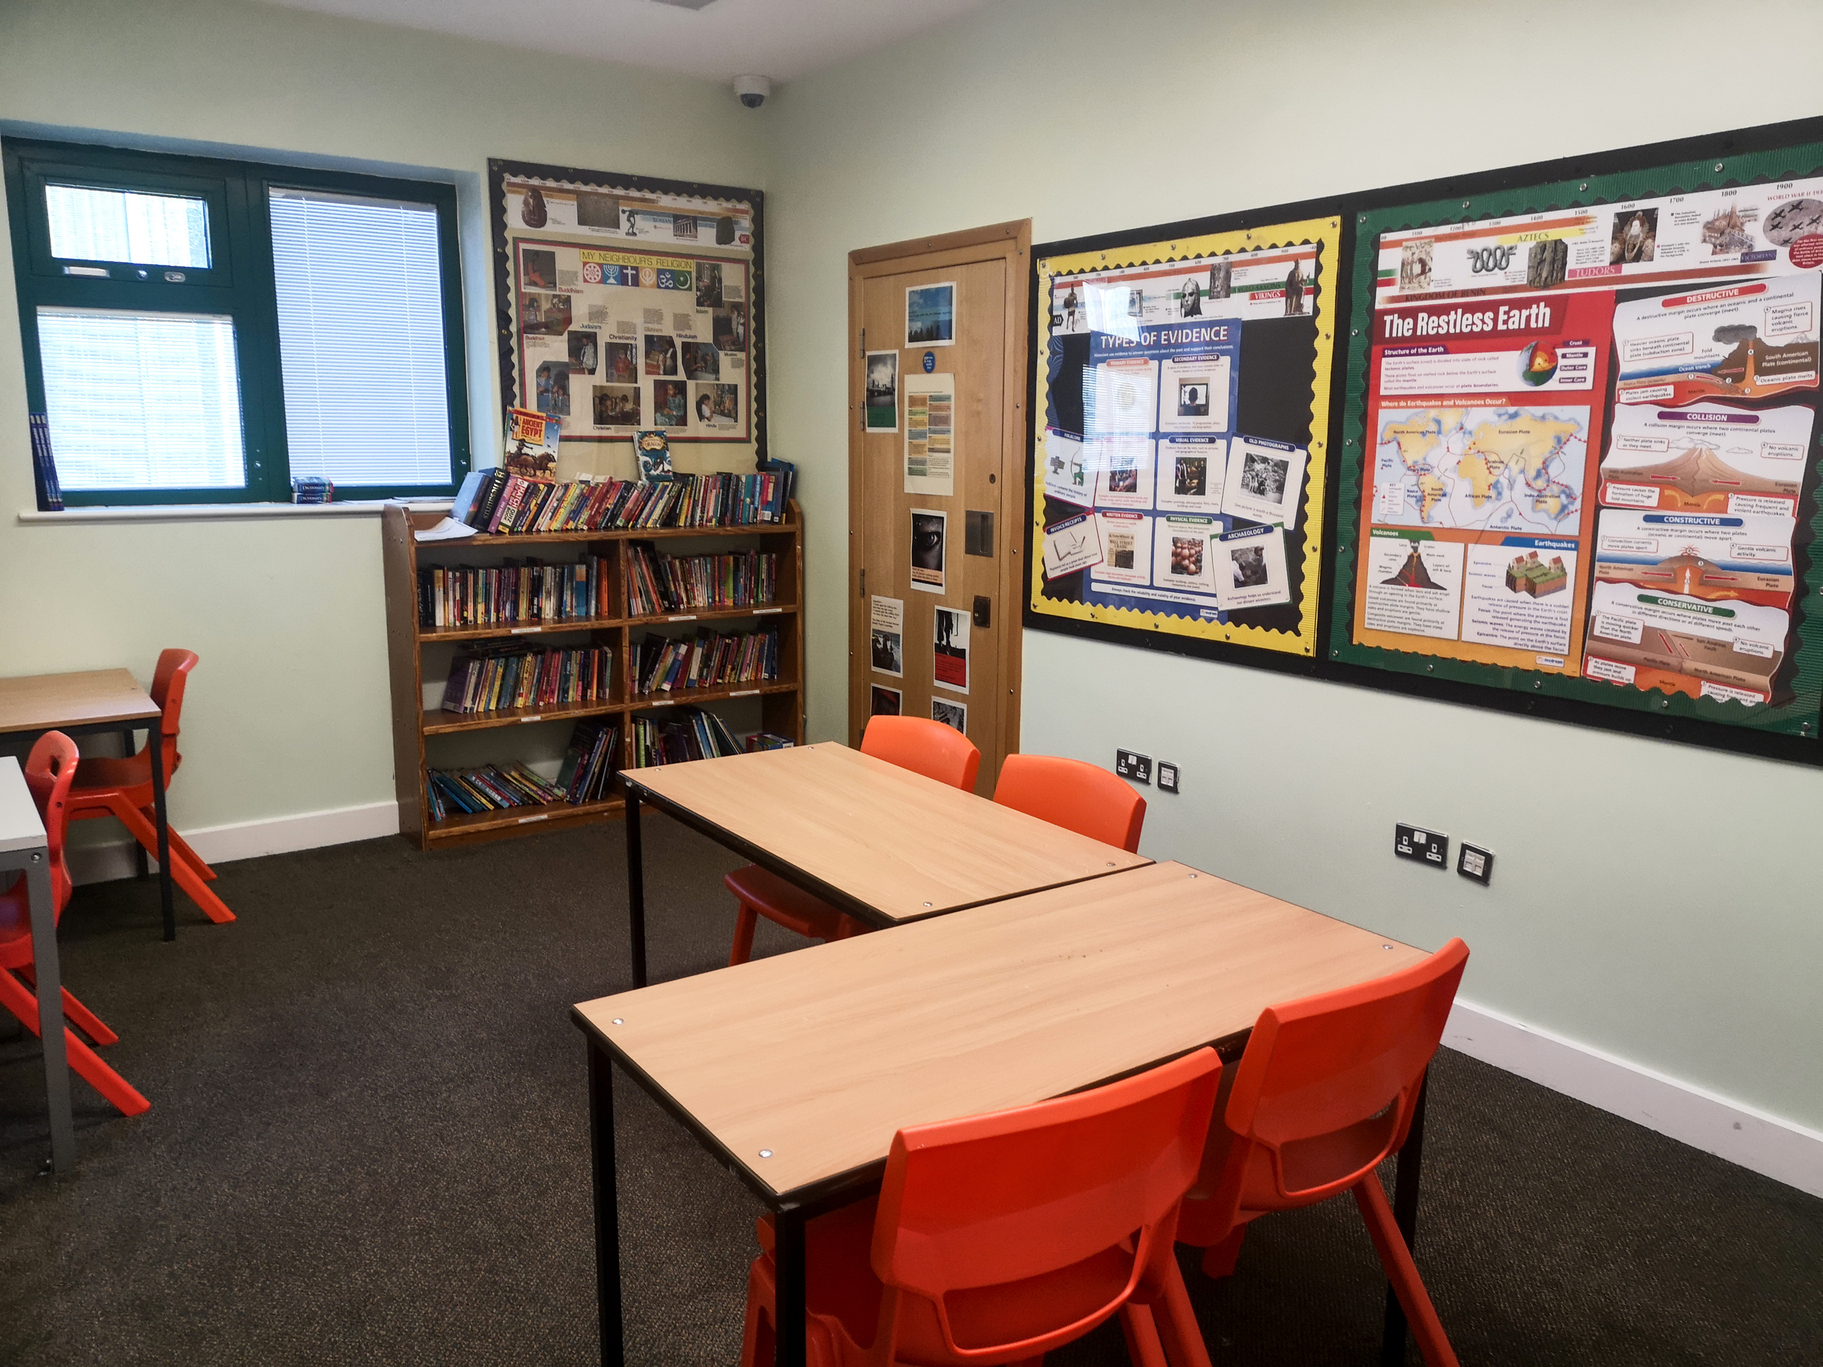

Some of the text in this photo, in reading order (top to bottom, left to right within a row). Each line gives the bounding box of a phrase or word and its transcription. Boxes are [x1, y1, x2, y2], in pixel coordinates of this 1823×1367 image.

[1517, 232, 1549, 243] AZTECS
[582, 252, 692, 269] MY NEIGHBOUR'S RELIGION
[1575, 266, 1616, 277] TUDORS
[1255, 291, 1280, 299] VIKINGS
[1405, 292, 1447, 303] KINGDOM
[1686, 289, 1739, 303] DESTRUCTIVE
[1763, 292, 1794, 301] continental
[1384, 302, 1551, 338] The Restless Earth
[1101, 326, 1229, 348] TYPES OF EVIDENCE
[522, 418, 543, 428] ANCIENT
[1686, 413, 1727, 422] COLLISION
[521, 426, 543, 438] EGYPT
[1664, 516, 1720, 525] CONSTRUCTIVE
[1228, 528, 1264, 539] ARCHAEOLOGY
[1535, 540, 1575, 548] Earthquakes
[1657, 598, 1714, 614] CONSERVATIVE
